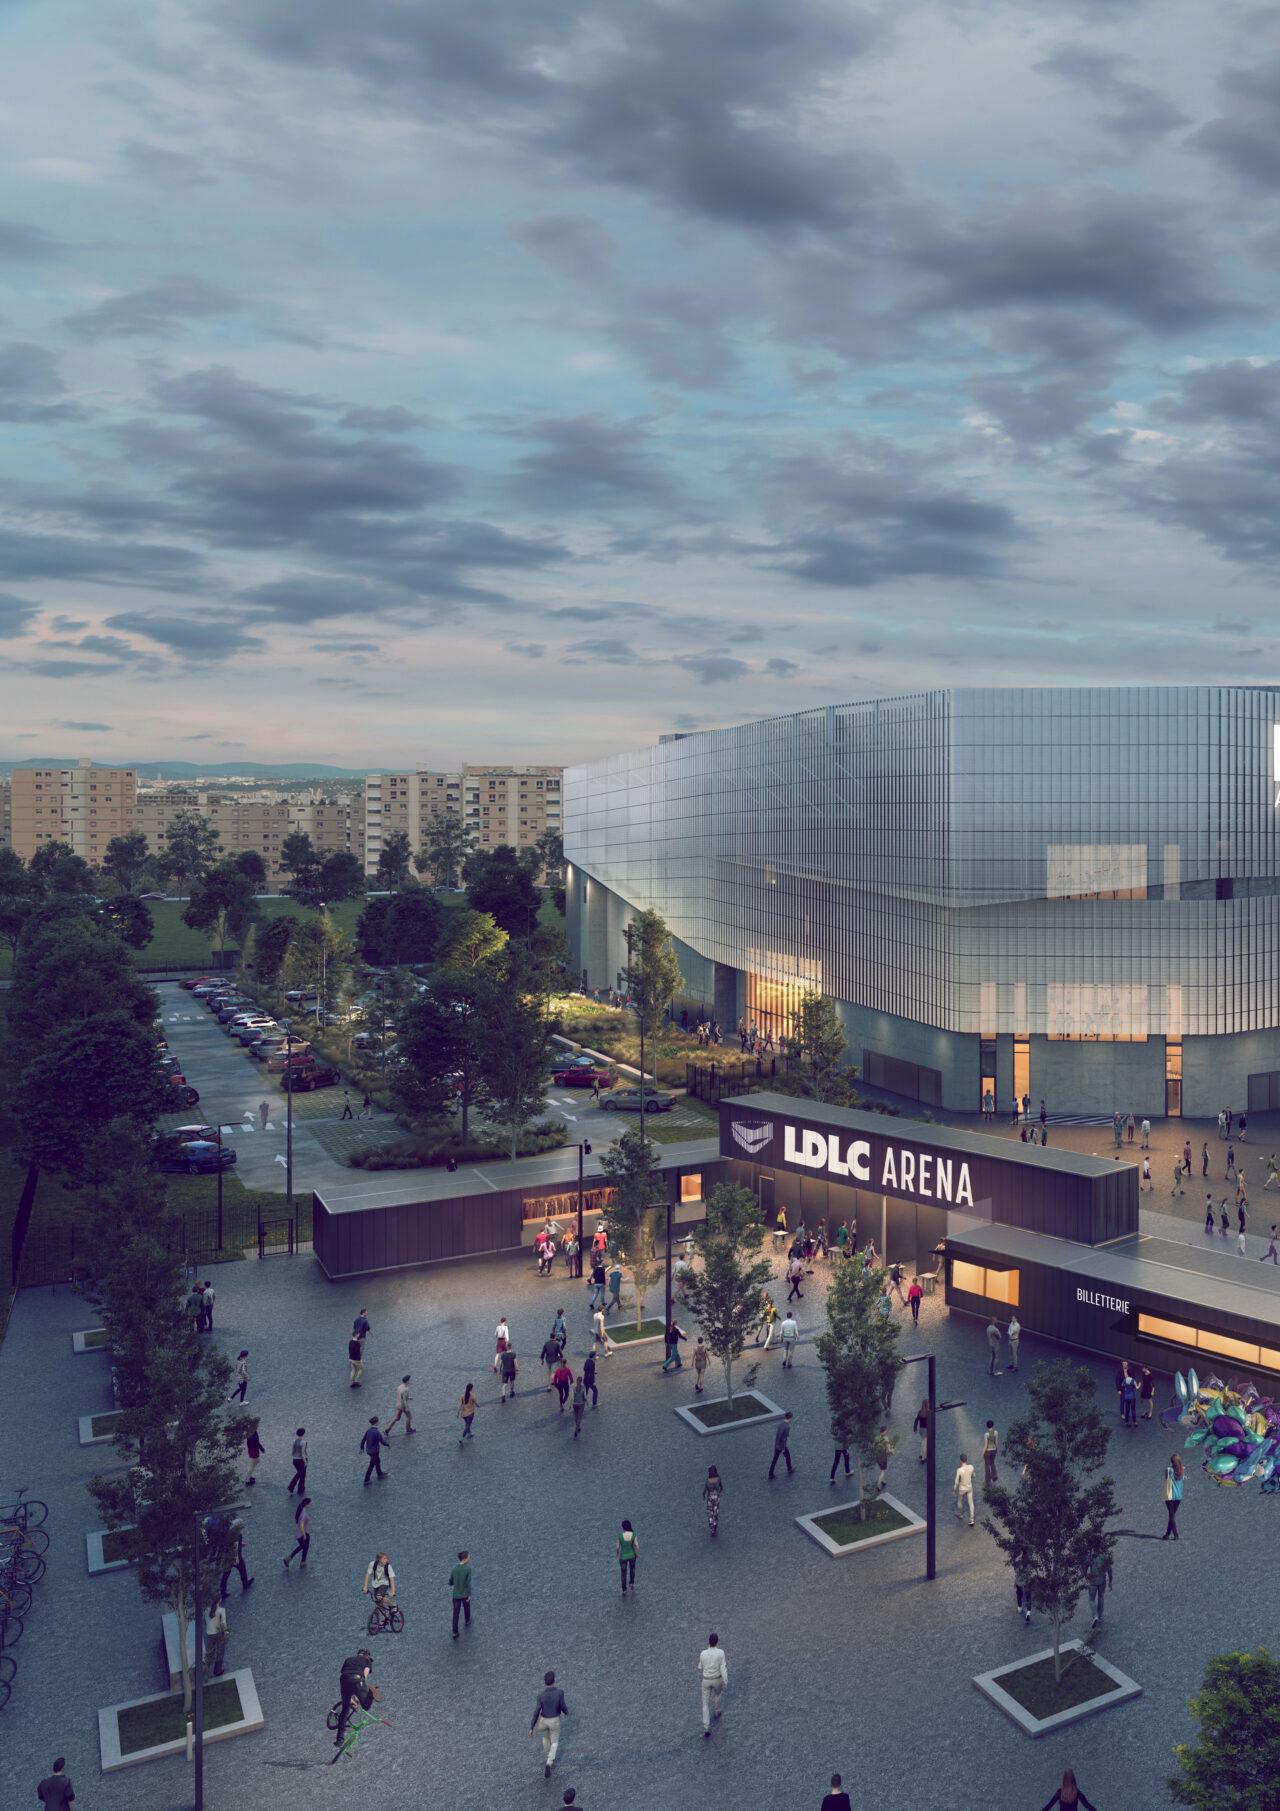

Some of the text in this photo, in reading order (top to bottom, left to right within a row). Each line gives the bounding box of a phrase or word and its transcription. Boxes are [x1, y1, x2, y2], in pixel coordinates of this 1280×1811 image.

[784, 1125, 974, 1207] LDLC ARENA
[1076, 1287, 1130, 1315] BILLETTERIE
